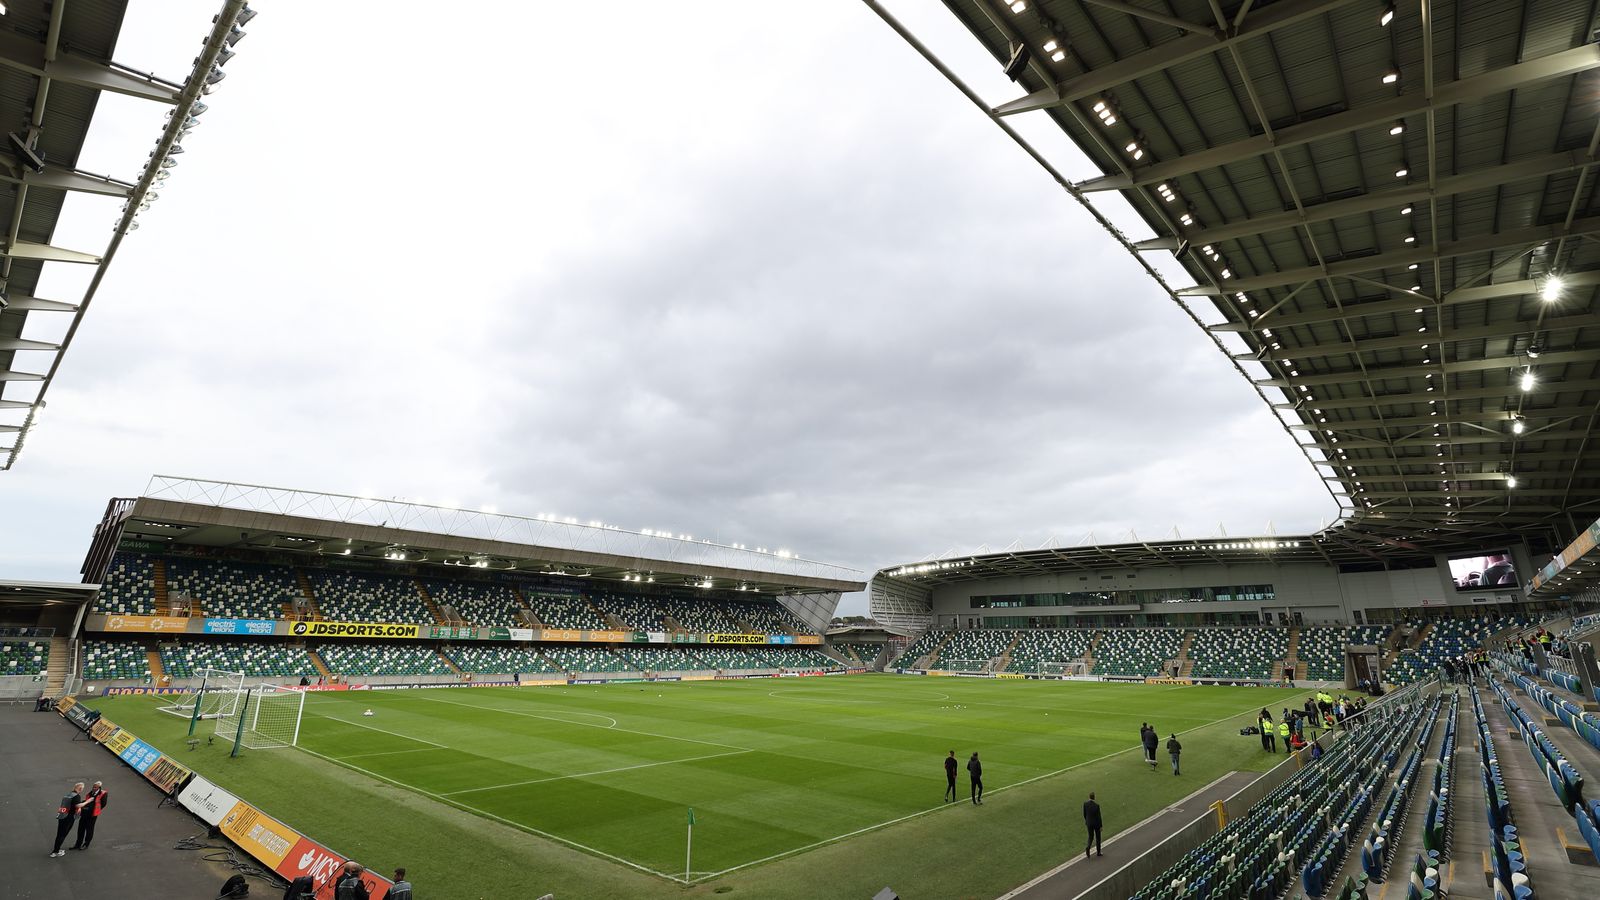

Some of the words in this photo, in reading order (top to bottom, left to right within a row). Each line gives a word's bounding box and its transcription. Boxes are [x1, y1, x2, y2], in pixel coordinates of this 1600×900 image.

[120, 540, 150, 549] GAWA
[309, 623, 417, 637] JDSPORTS.COM
[715, 634, 764, 643] JDSPORTS.COM
